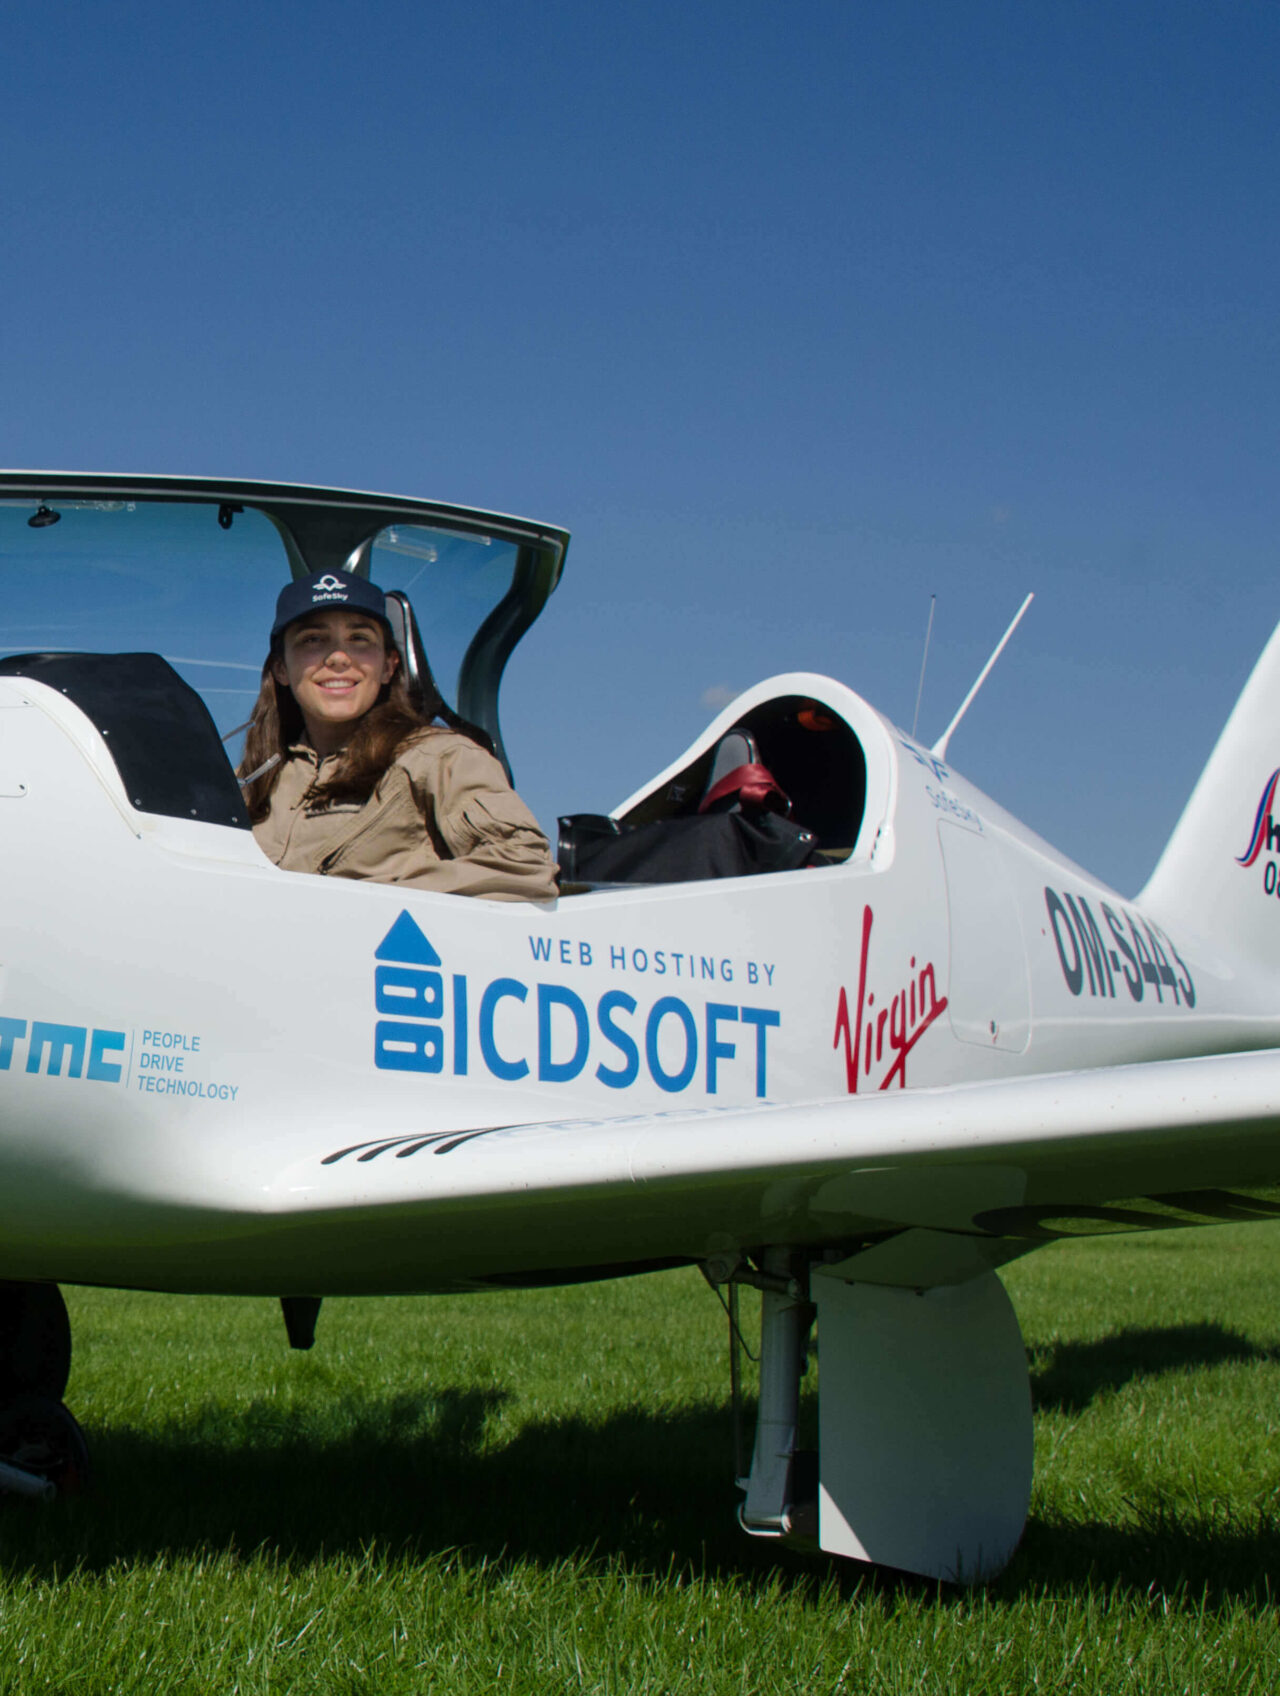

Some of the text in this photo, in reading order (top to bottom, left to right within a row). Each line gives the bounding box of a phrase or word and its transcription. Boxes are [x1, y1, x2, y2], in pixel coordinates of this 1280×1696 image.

[312, 592, 349, 602] SafeSky
[528, 935, 776, 986] WEB HOSTING BY
[1044, 886, 1196, 1009] OM-S443
[833, 904, 948, 1093] Virgin
[143, 1030, 201, 1052] PEOPLE
[452, 973, 781, 1098] ICDSOFT
[140, 1053, 184, 1072] DRIVE
[137, 1075, 239, 1101] TECHNOLOGY
